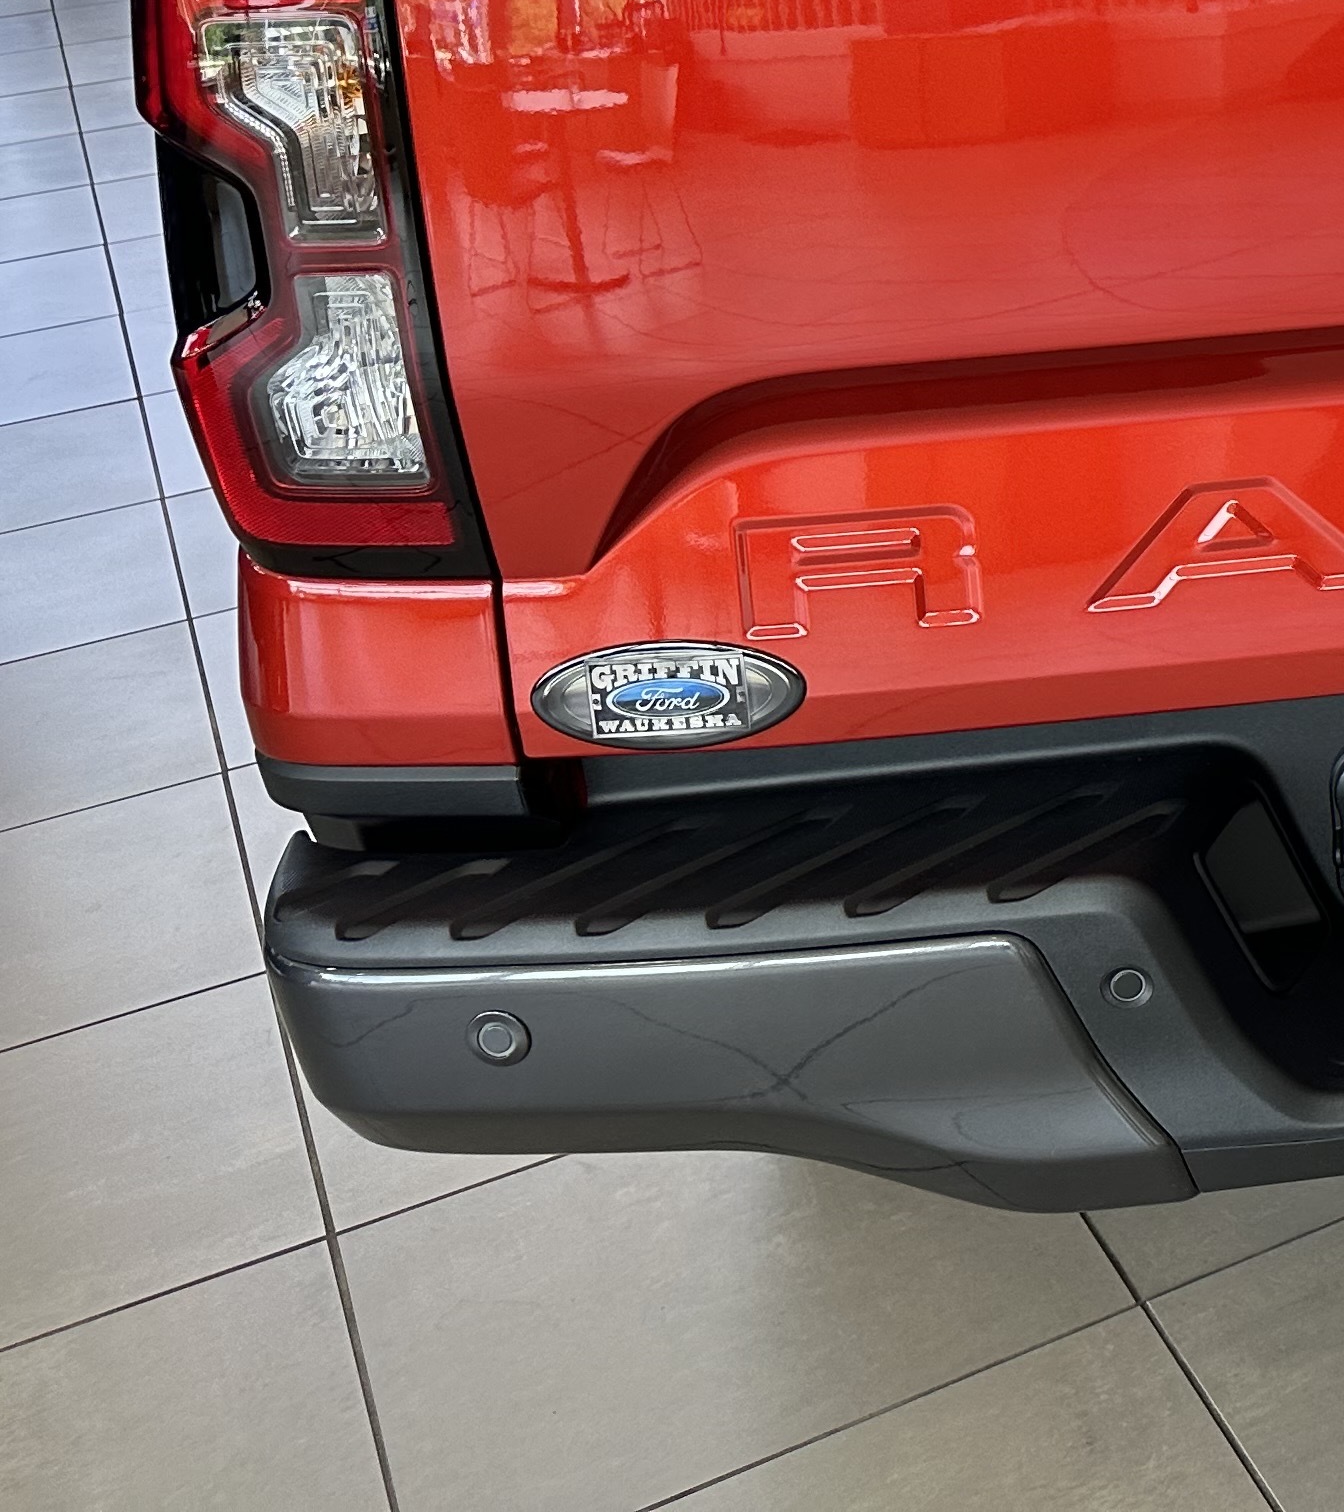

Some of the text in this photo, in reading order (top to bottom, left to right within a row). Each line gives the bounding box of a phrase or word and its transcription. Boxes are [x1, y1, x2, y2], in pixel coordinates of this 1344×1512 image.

[591, 659, 741, 692] GRIFFIN
[635, 687, 700, 711] Ford
[598, 713, 742, 734] WAUKESHA
